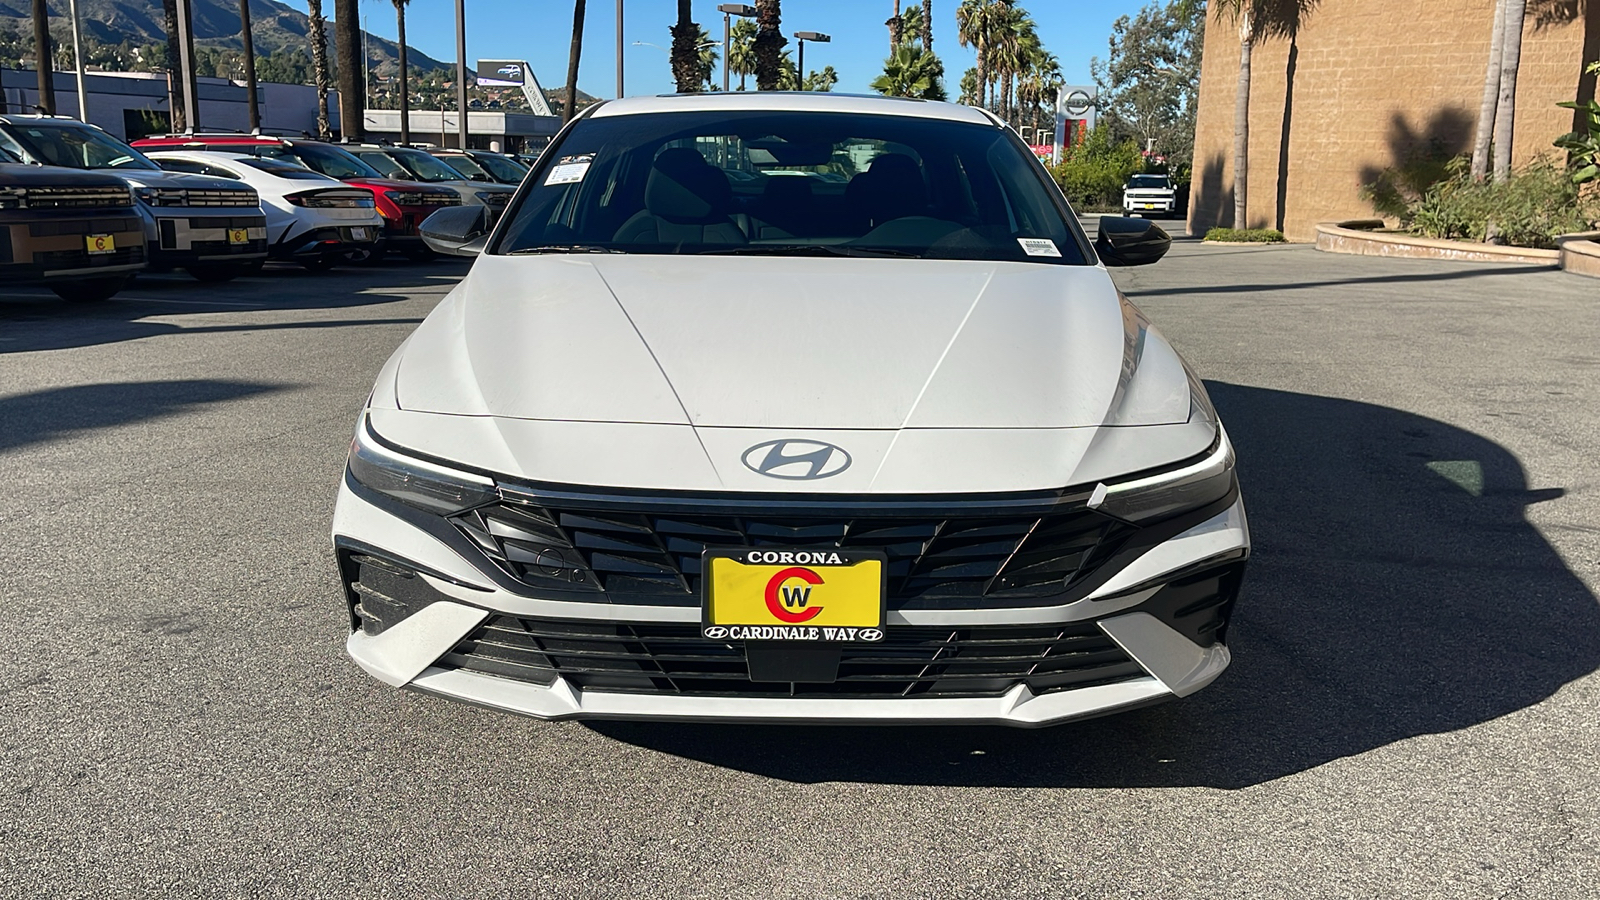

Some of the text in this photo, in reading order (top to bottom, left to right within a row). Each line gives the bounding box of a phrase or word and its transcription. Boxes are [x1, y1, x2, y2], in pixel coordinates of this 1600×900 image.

[747, 551, 843, 565] CORONA
[782, 585, 813, 608] W
[729, 626, 859, 641] CARDINALE WAY
